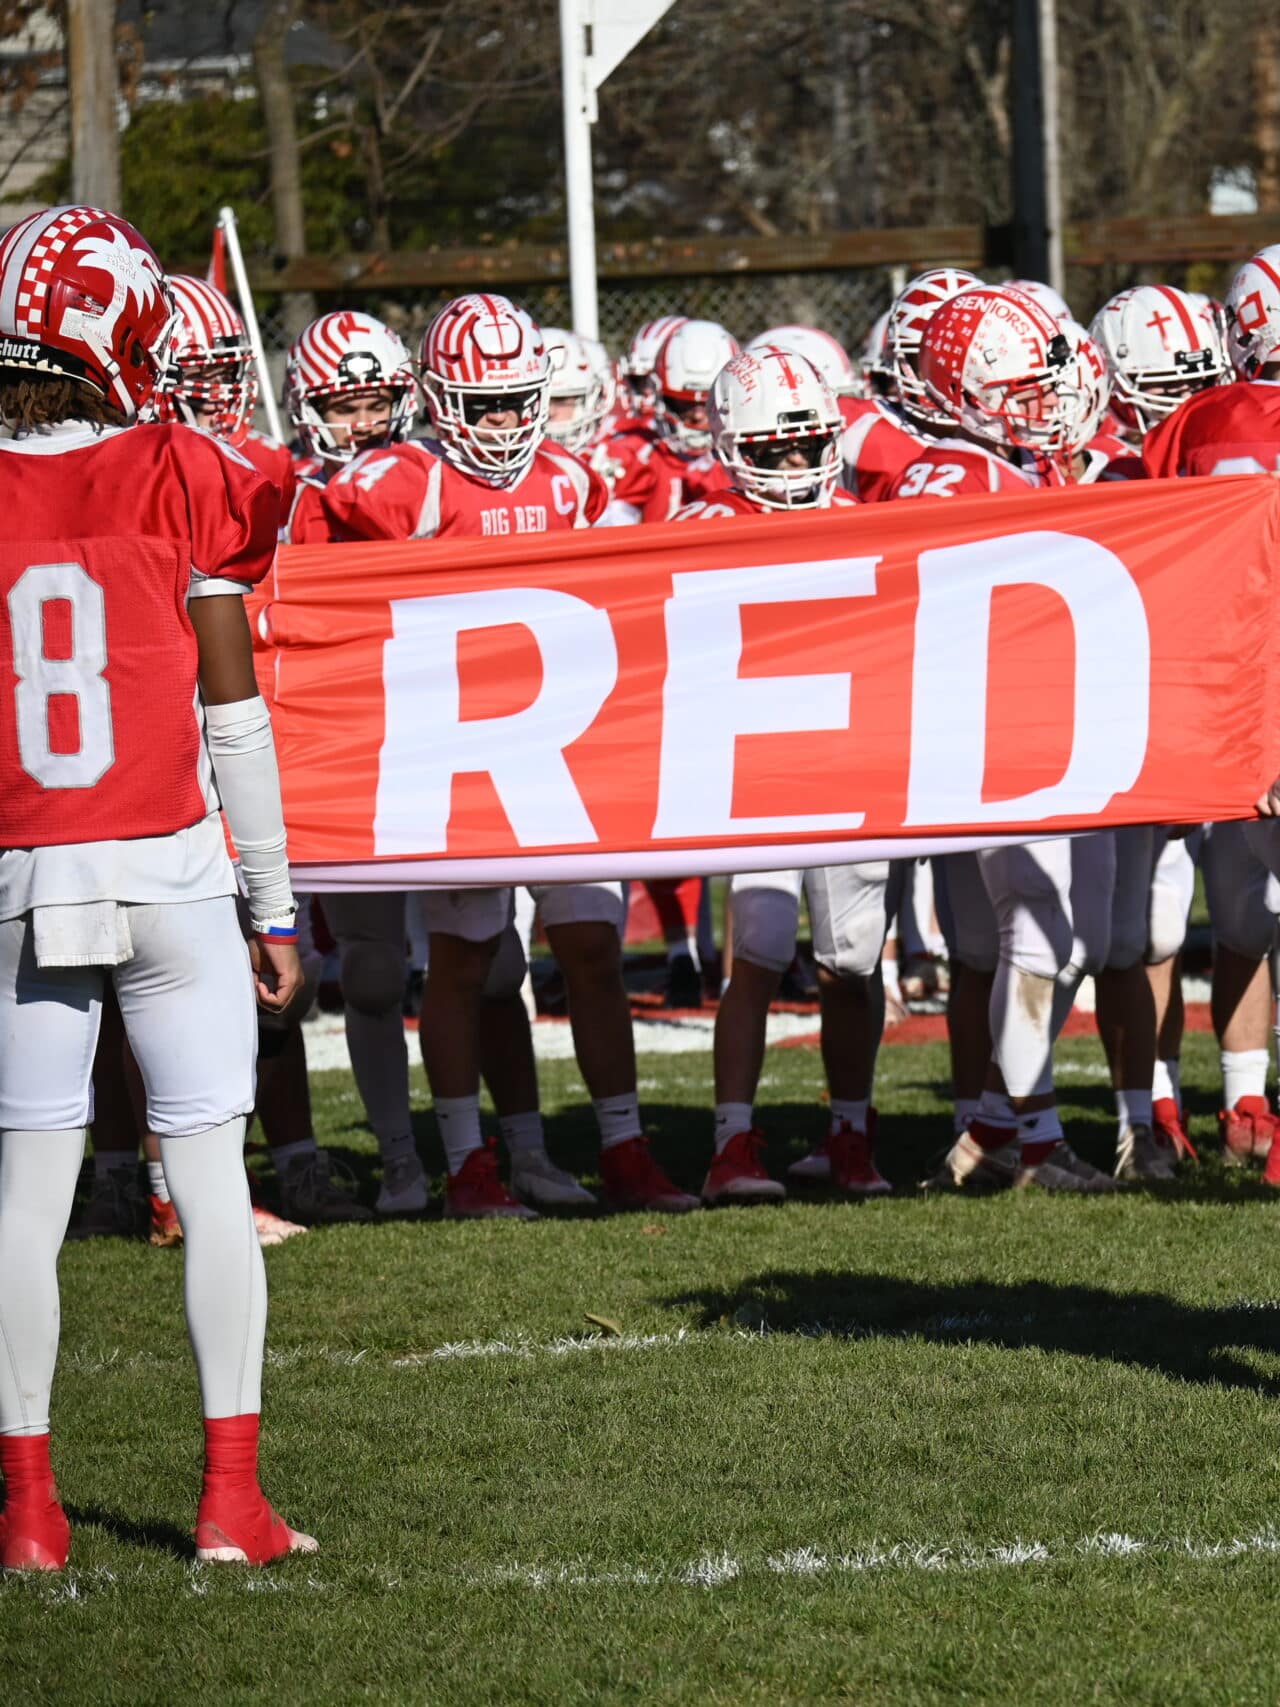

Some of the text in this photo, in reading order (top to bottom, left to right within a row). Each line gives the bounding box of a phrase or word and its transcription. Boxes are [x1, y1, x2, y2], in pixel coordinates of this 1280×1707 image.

[952, 295, 1031, 336] SENIORS
[550, 474, 576, 516] C
[899, 462, 967, 498] 32
[480, 505, 548, 537] BIG RED
[7, 561, 117, 789] 8
[374, 530, 1152, 856] RED
